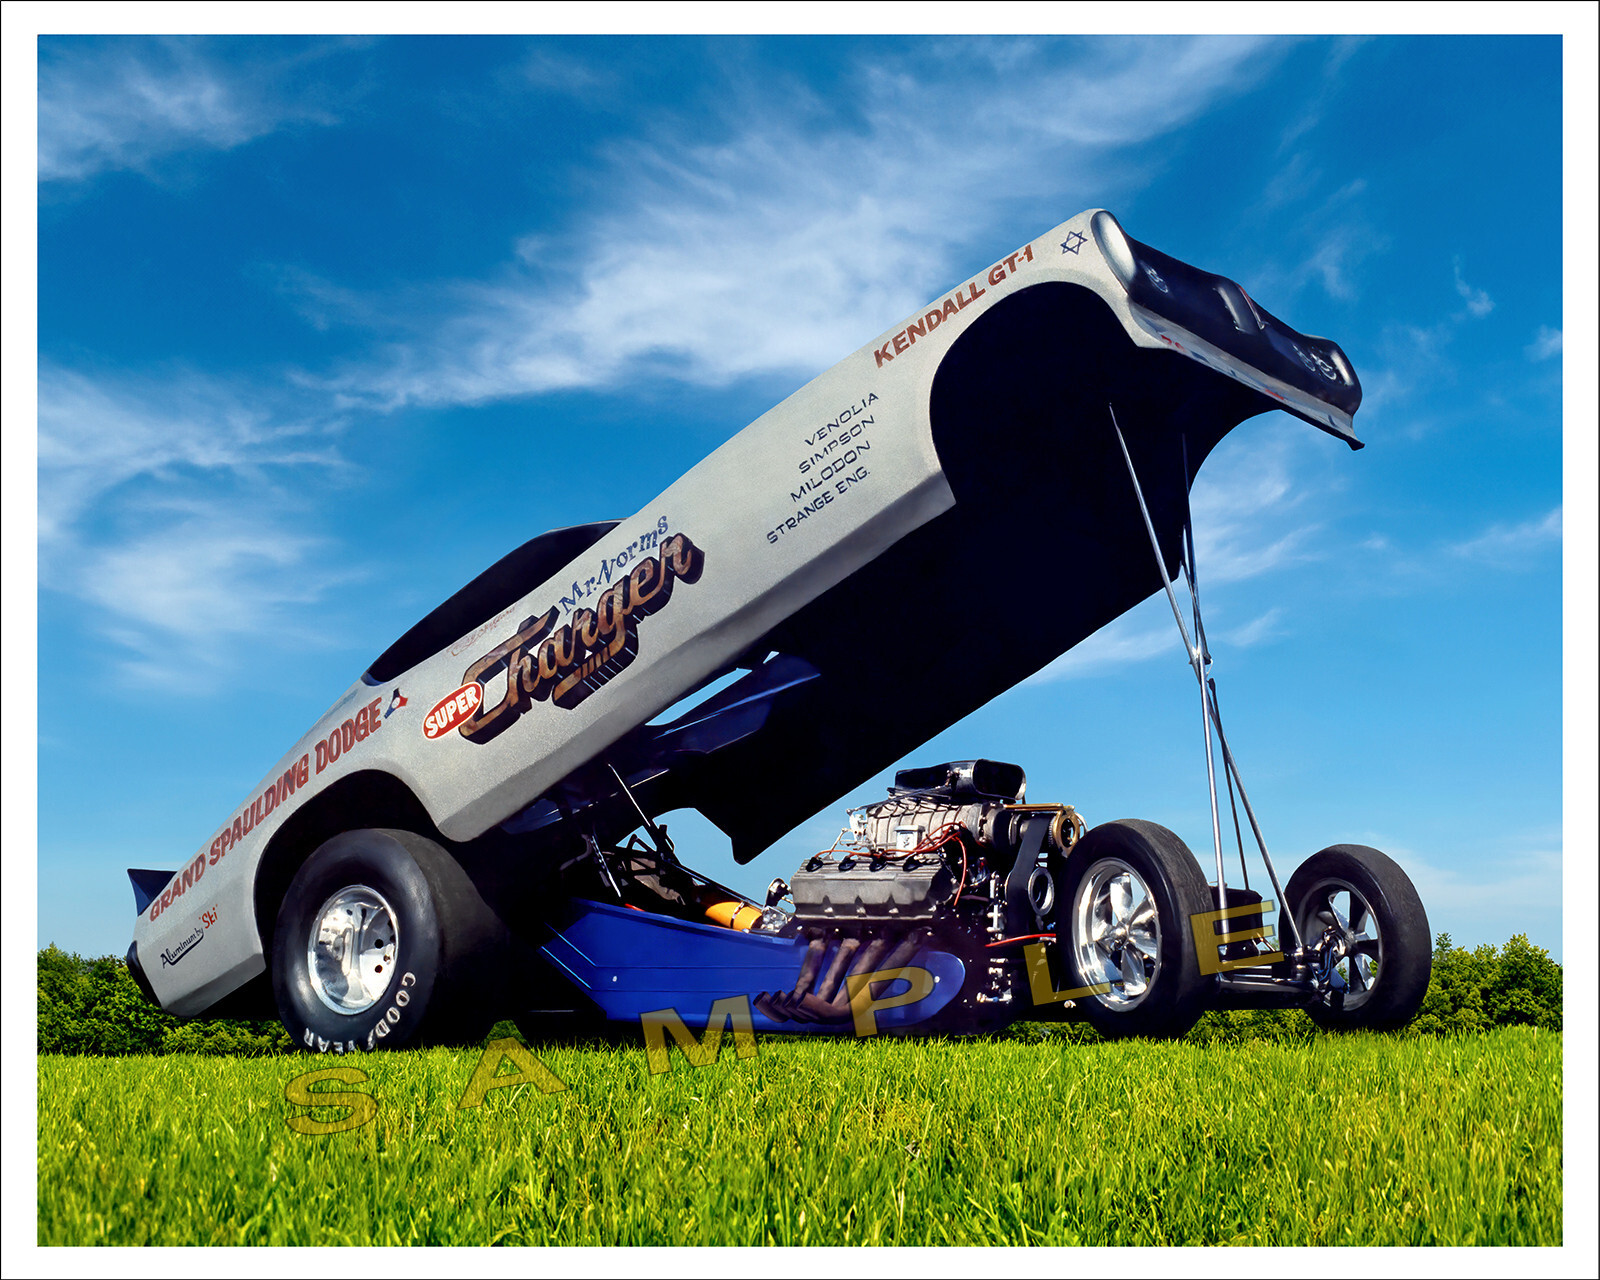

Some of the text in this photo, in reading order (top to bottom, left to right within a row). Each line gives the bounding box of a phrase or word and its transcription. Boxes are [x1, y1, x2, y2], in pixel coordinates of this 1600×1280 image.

[873, 245, 1035, 369] KENDALL GT-1
[798, 414, 875, 474] SIMPSON
[804, 392, 879, 446] VENOLIA
[766, 466, 871, 544] STRANGE ENG.
[790, 440, 871, 502] MILODON
[424, 686, 480, 738] SUPER
[457, 532, 705, 746] Charger
[149, 696, 382, 922] GRAND SPAULDING DODGE
[160, 932, 198, 969] Aluminum
